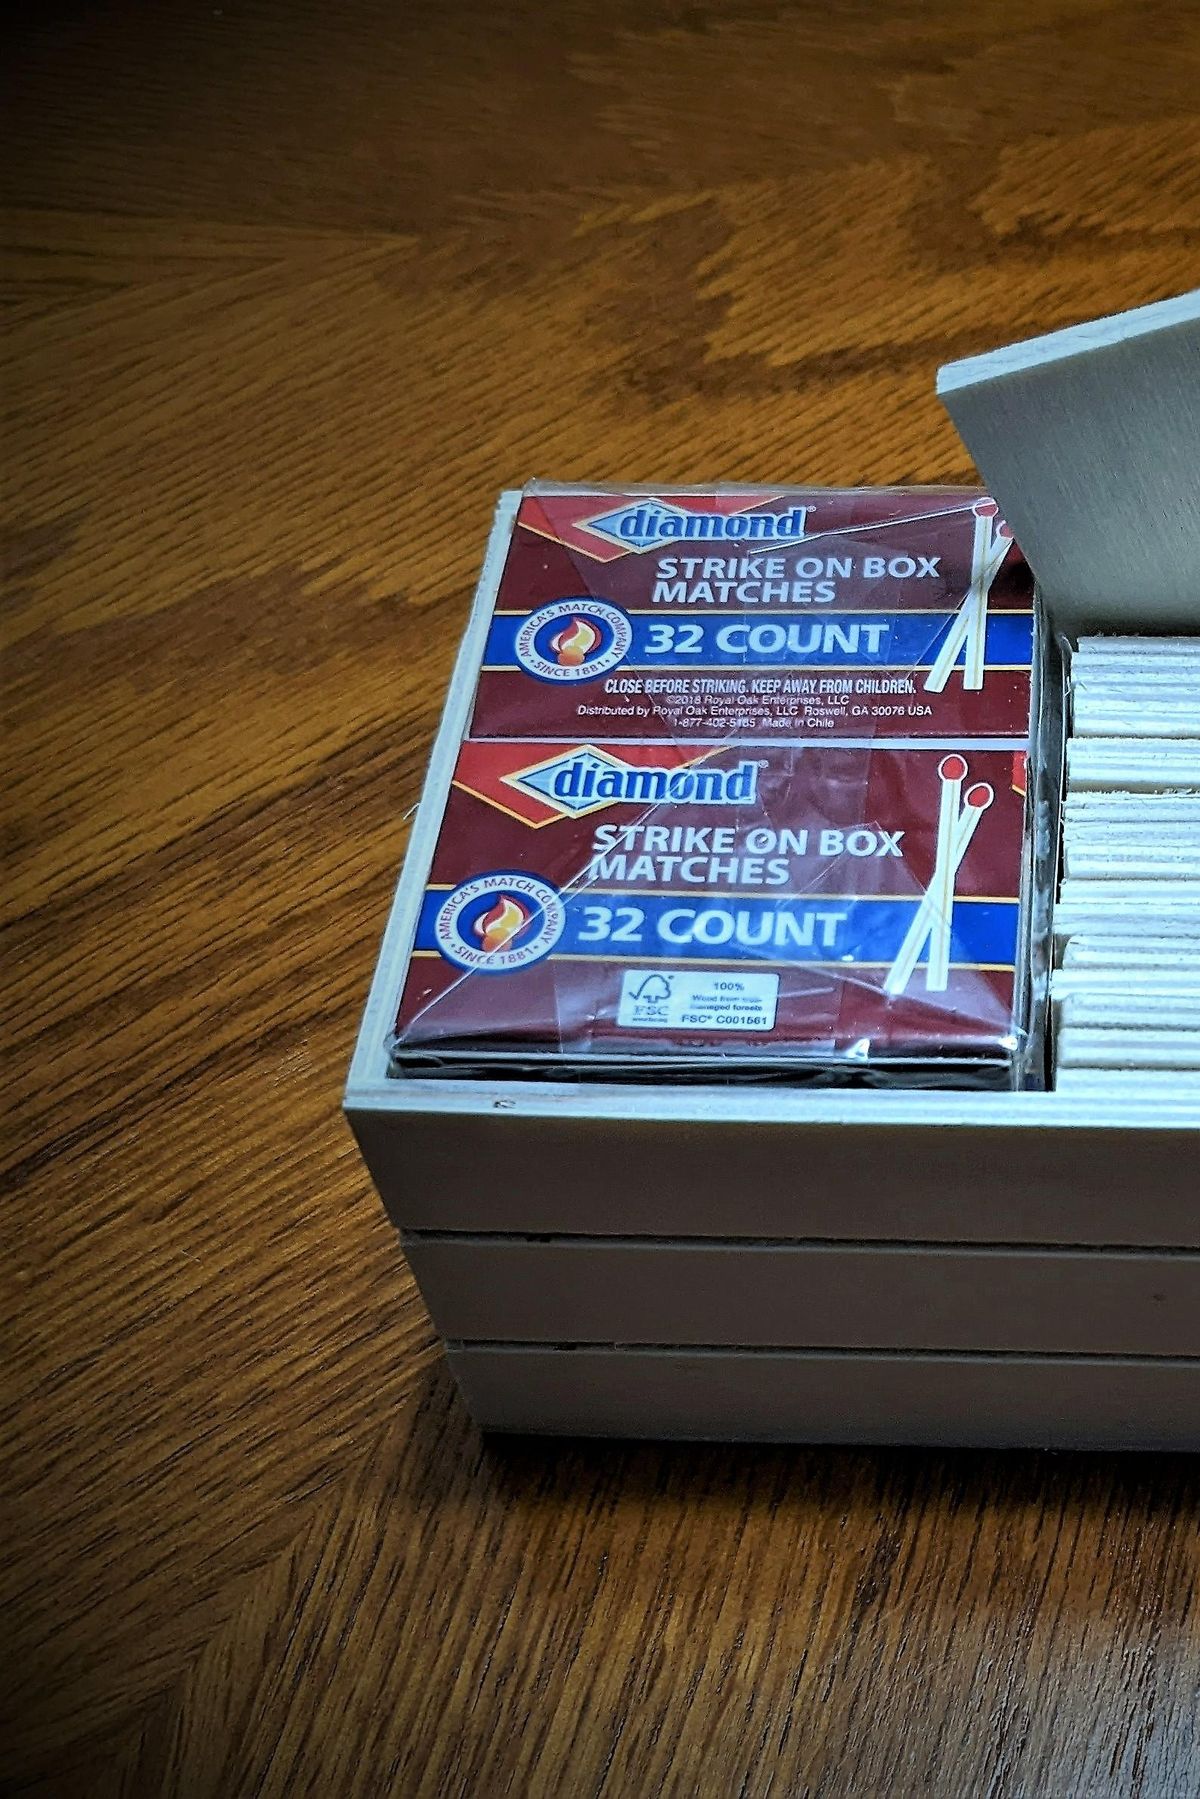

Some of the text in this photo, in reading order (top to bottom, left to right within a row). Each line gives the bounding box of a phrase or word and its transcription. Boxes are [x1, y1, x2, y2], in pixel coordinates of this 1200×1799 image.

[656, 556, 941, 580] STRIKE ON BOX
[652, 581, 836, 603] MATCHES
[519, 603, 627, 658] AMERICA'S MATCH COMPANY
[644, 624, 890, 654] 32 COUNT
[534, 660, 606, 677] SINCE 1881
[604, 679, 917, 694] CLOSE BEFORE STRIKING. KEEP AWAY FROM CHILDREN.
[704, 695, 735, 707] Royal
[737, 695, 759, 705] Oak
[828, 695, 850, 705] LLC
[577, 705, 634, 716] Distributed
[637, 705, 650, 718] by
[652, 706, 683, 718] Royal
[685, 706, 708, 716] Oak
[776, 706, 798, 716] LLC
[852, 706, 869, 716] GA
[871, 706, 905, 716] 30076
[907, 706, 932, 716] USA
[807, 718, 834, 728] Chile
[592, 825, 905, 857] STRIKE ON BOX
[588, 854, 789, 885] MATCHES
[439, 885, 479, 940] AMERICA'S
[484, 878, 535, 892] MATCH
[578, 906, 847, 947] 32 COUNT
[454, 946, 534, 964] SINCE 1881
[714, 982, 744, 991] 100%
[634, 1005, 669, 1016] FSC
